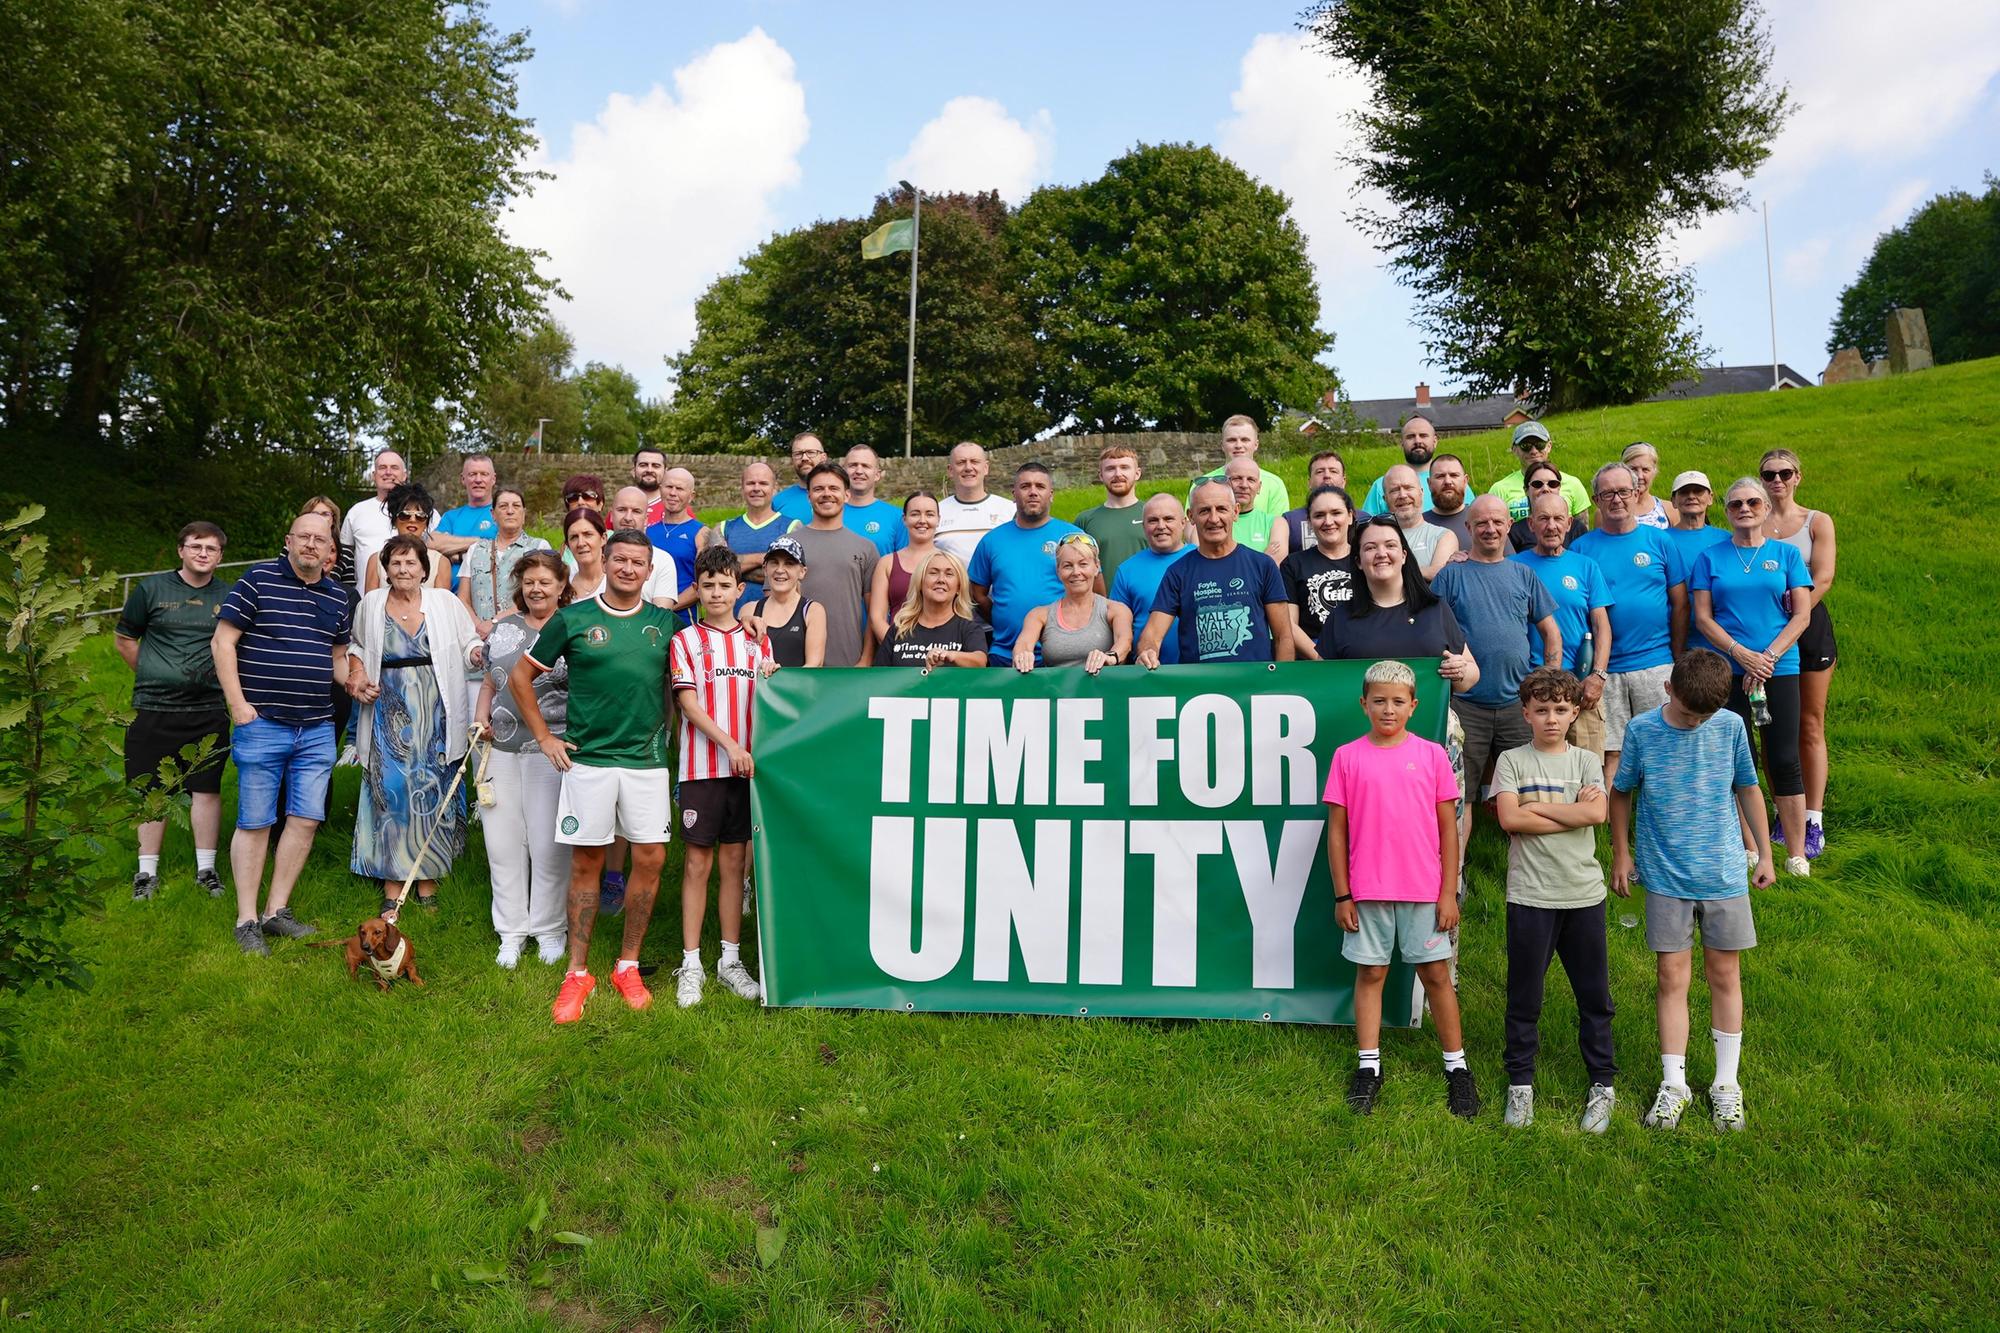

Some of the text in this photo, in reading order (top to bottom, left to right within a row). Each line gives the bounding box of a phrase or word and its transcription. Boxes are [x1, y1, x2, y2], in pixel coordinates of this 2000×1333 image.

[1198, 581, 1217, 589] Foyle
[1194, 587, 1222, 597] Hospice
[1198, 612, 1229, 622] MALE
[1198, 620, 1233, 633] WALK
[1200, 631, 1223, 643] RUN
[1200, 641, 1228, 653] 2024
[715, 668, 755, 679] DIAMOND
[868, 694, 1317, 808] TIME FOR
[868, 815, 1325, 989] UNITY
